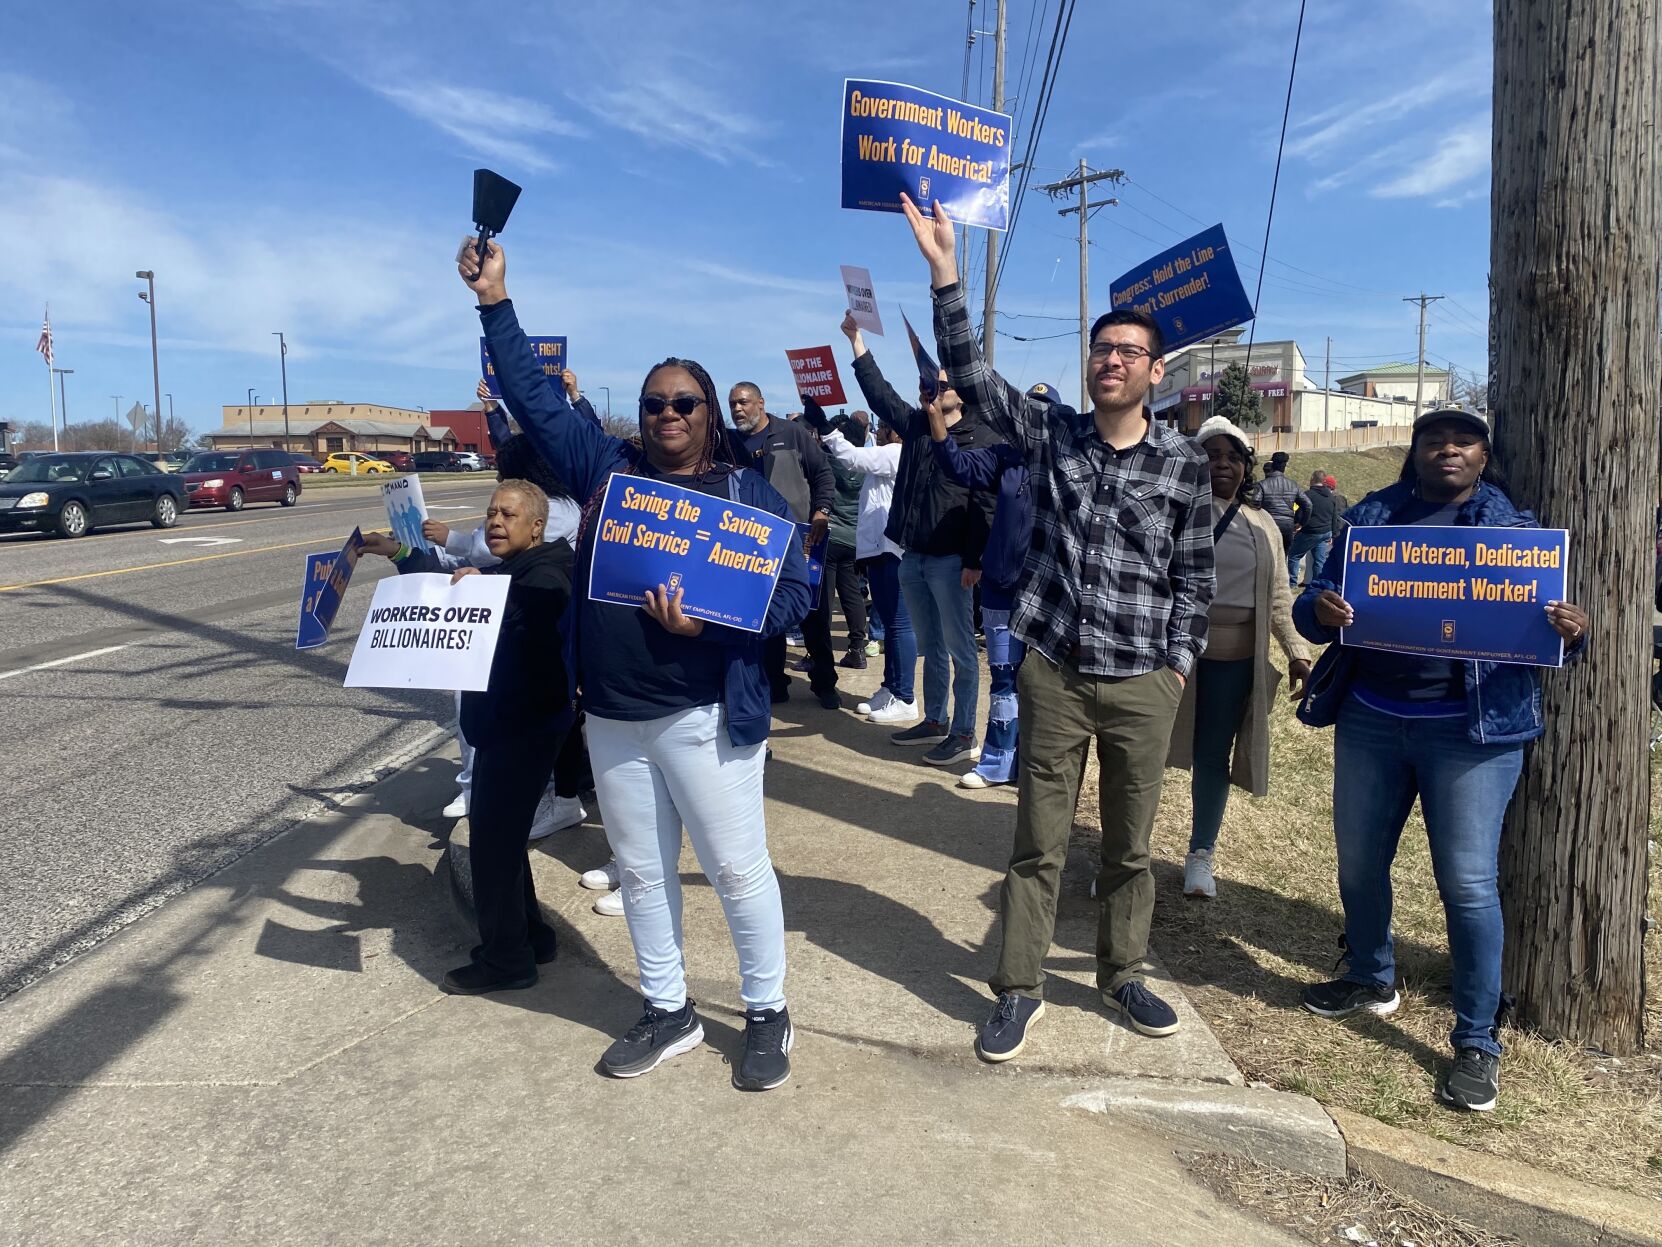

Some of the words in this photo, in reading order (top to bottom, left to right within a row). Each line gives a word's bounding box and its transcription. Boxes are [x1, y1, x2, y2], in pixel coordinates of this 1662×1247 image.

[851, 90, 943, 130] Government
[947, 109, 1005, 147] Workers
[858, 134, 897, 162] Work
[901, 138, 925, 165] for
[927, 145, 992, 183] America!
[1112, 277, 1153, 306] Congress:
[1153, 262, 1174, 285] Hold
[1175, 257, 1192, 274] the
[1192, 246, 1214, 266] Line
[1158, 271, 1211, 308] Surrender!
[539, 343, 562, 357] FIGHT
[805, 356, 823, 369] THE
[1268, 388, 1285, 398] FREE
[621, 486, 673, 521] Saving
[674, 498, 701, 523] the
[718, 510, 772, 546] Saving
[601, 518, 632, 545] Civil
[633, 524, 691, 556] Service
[708, 541, 779, 577] America!
[1351, 541, 1397, 564] Proud
[1401, 541, 1470, 569] Veteran,
[1475, 543, 1560, 568] Dedicated
[1368, 574, 1466, 600] Government
[1471, 577, 1537, 602] Worker!
[370, 606, 440, 624] WORKERS
[443, 607, 492, 624] OVER
[370, 628, 473, 650] BILLIONAIRES!
